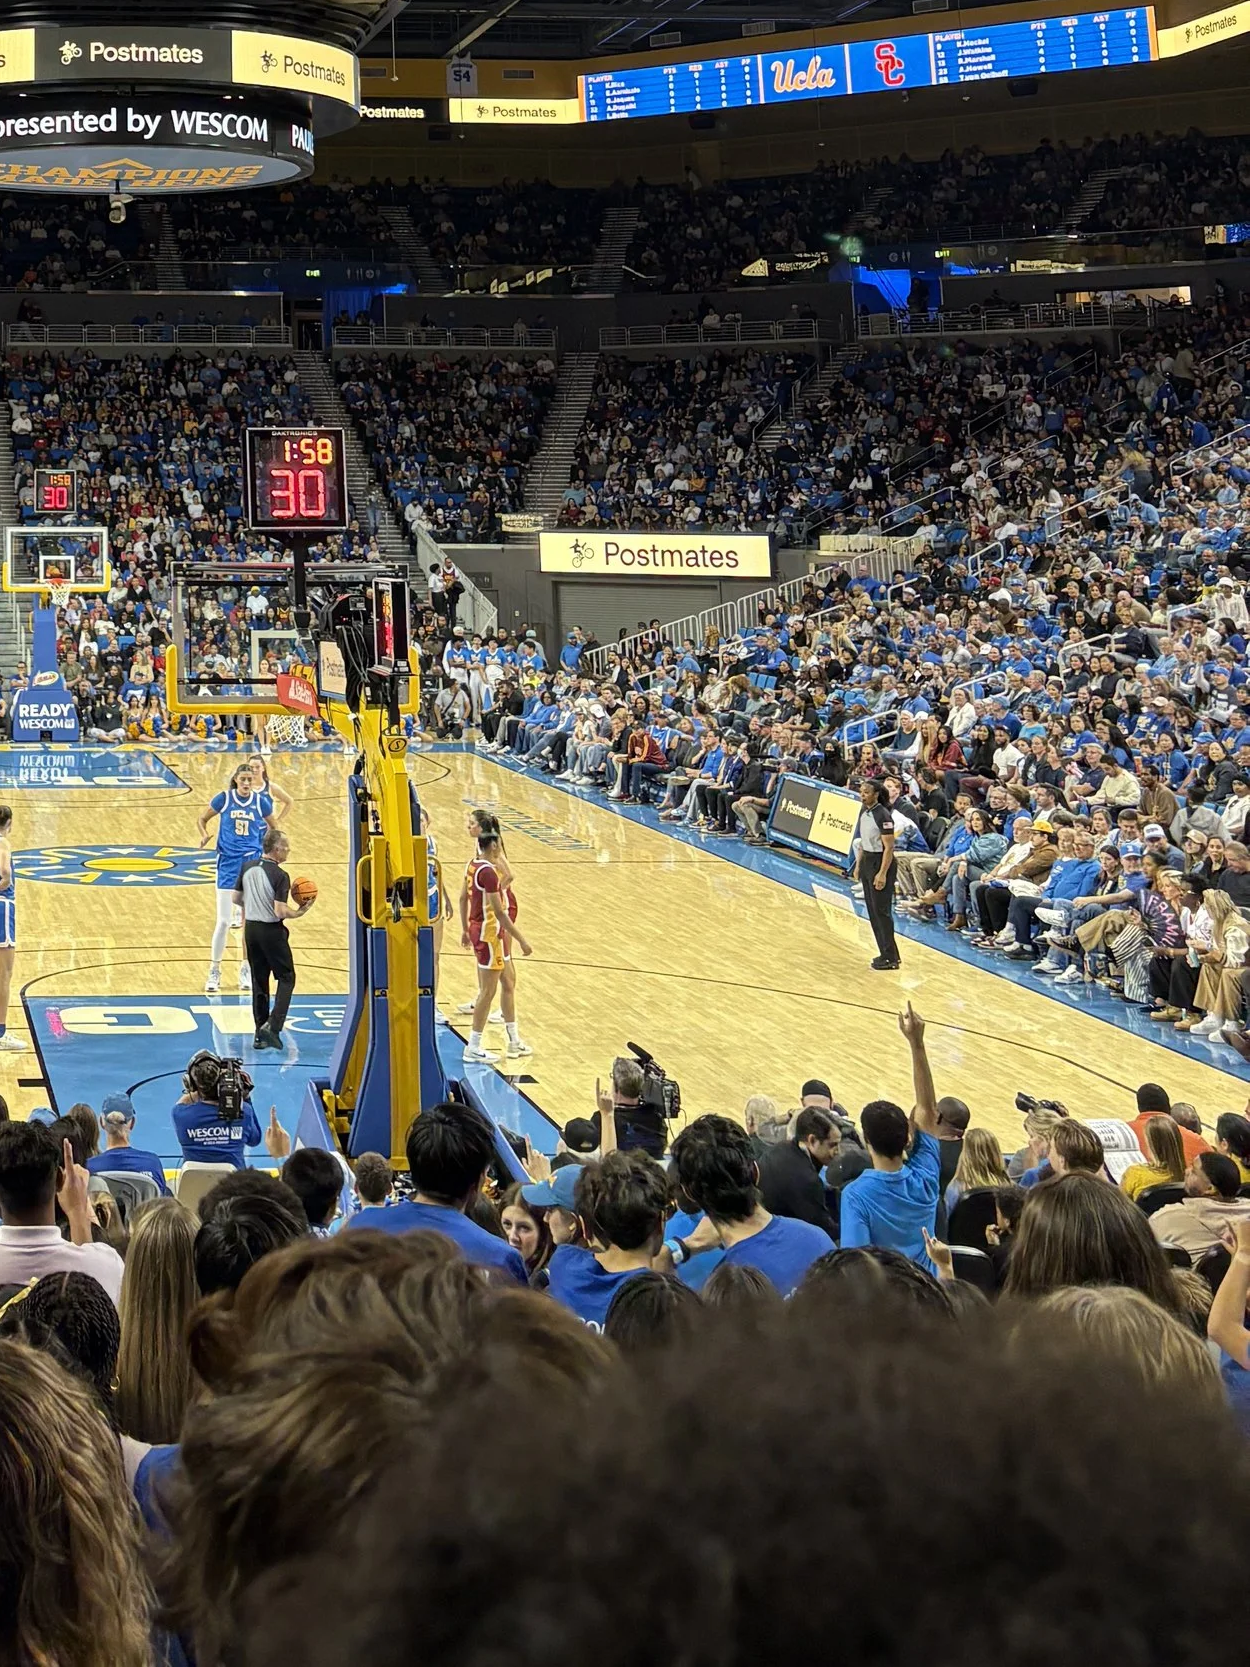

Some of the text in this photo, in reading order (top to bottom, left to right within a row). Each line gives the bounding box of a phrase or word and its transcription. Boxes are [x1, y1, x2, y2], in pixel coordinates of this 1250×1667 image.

[1194, 14, 1238, 40] Postmates
[90, 43, 204, 65] Postmates
[283, 56, 347, 87] Postmates
[453, 70, 471, 83] 54
[770, 54, 836, 94] Ucla
[359, 106, 425, 120] Postmates
[493, 106, 556, 119] Postmates
[126, 106, 162, 139] by
[171, 110, 269, 142] WESCOM
[284, 438, 333, 465] 1:58
[50, 474, 71, 486] 1:58
[43, 486, 68, 508] 30
[270, 469, 326, 518] 30
[604, 541, 739, 569] Postmates
[19, 703, 70, 717] READY
[19, 719, 64, 729] WESCOM
[235, 819, 250, 836] 51
[187, 1126, 230, 1138] WESCOM
